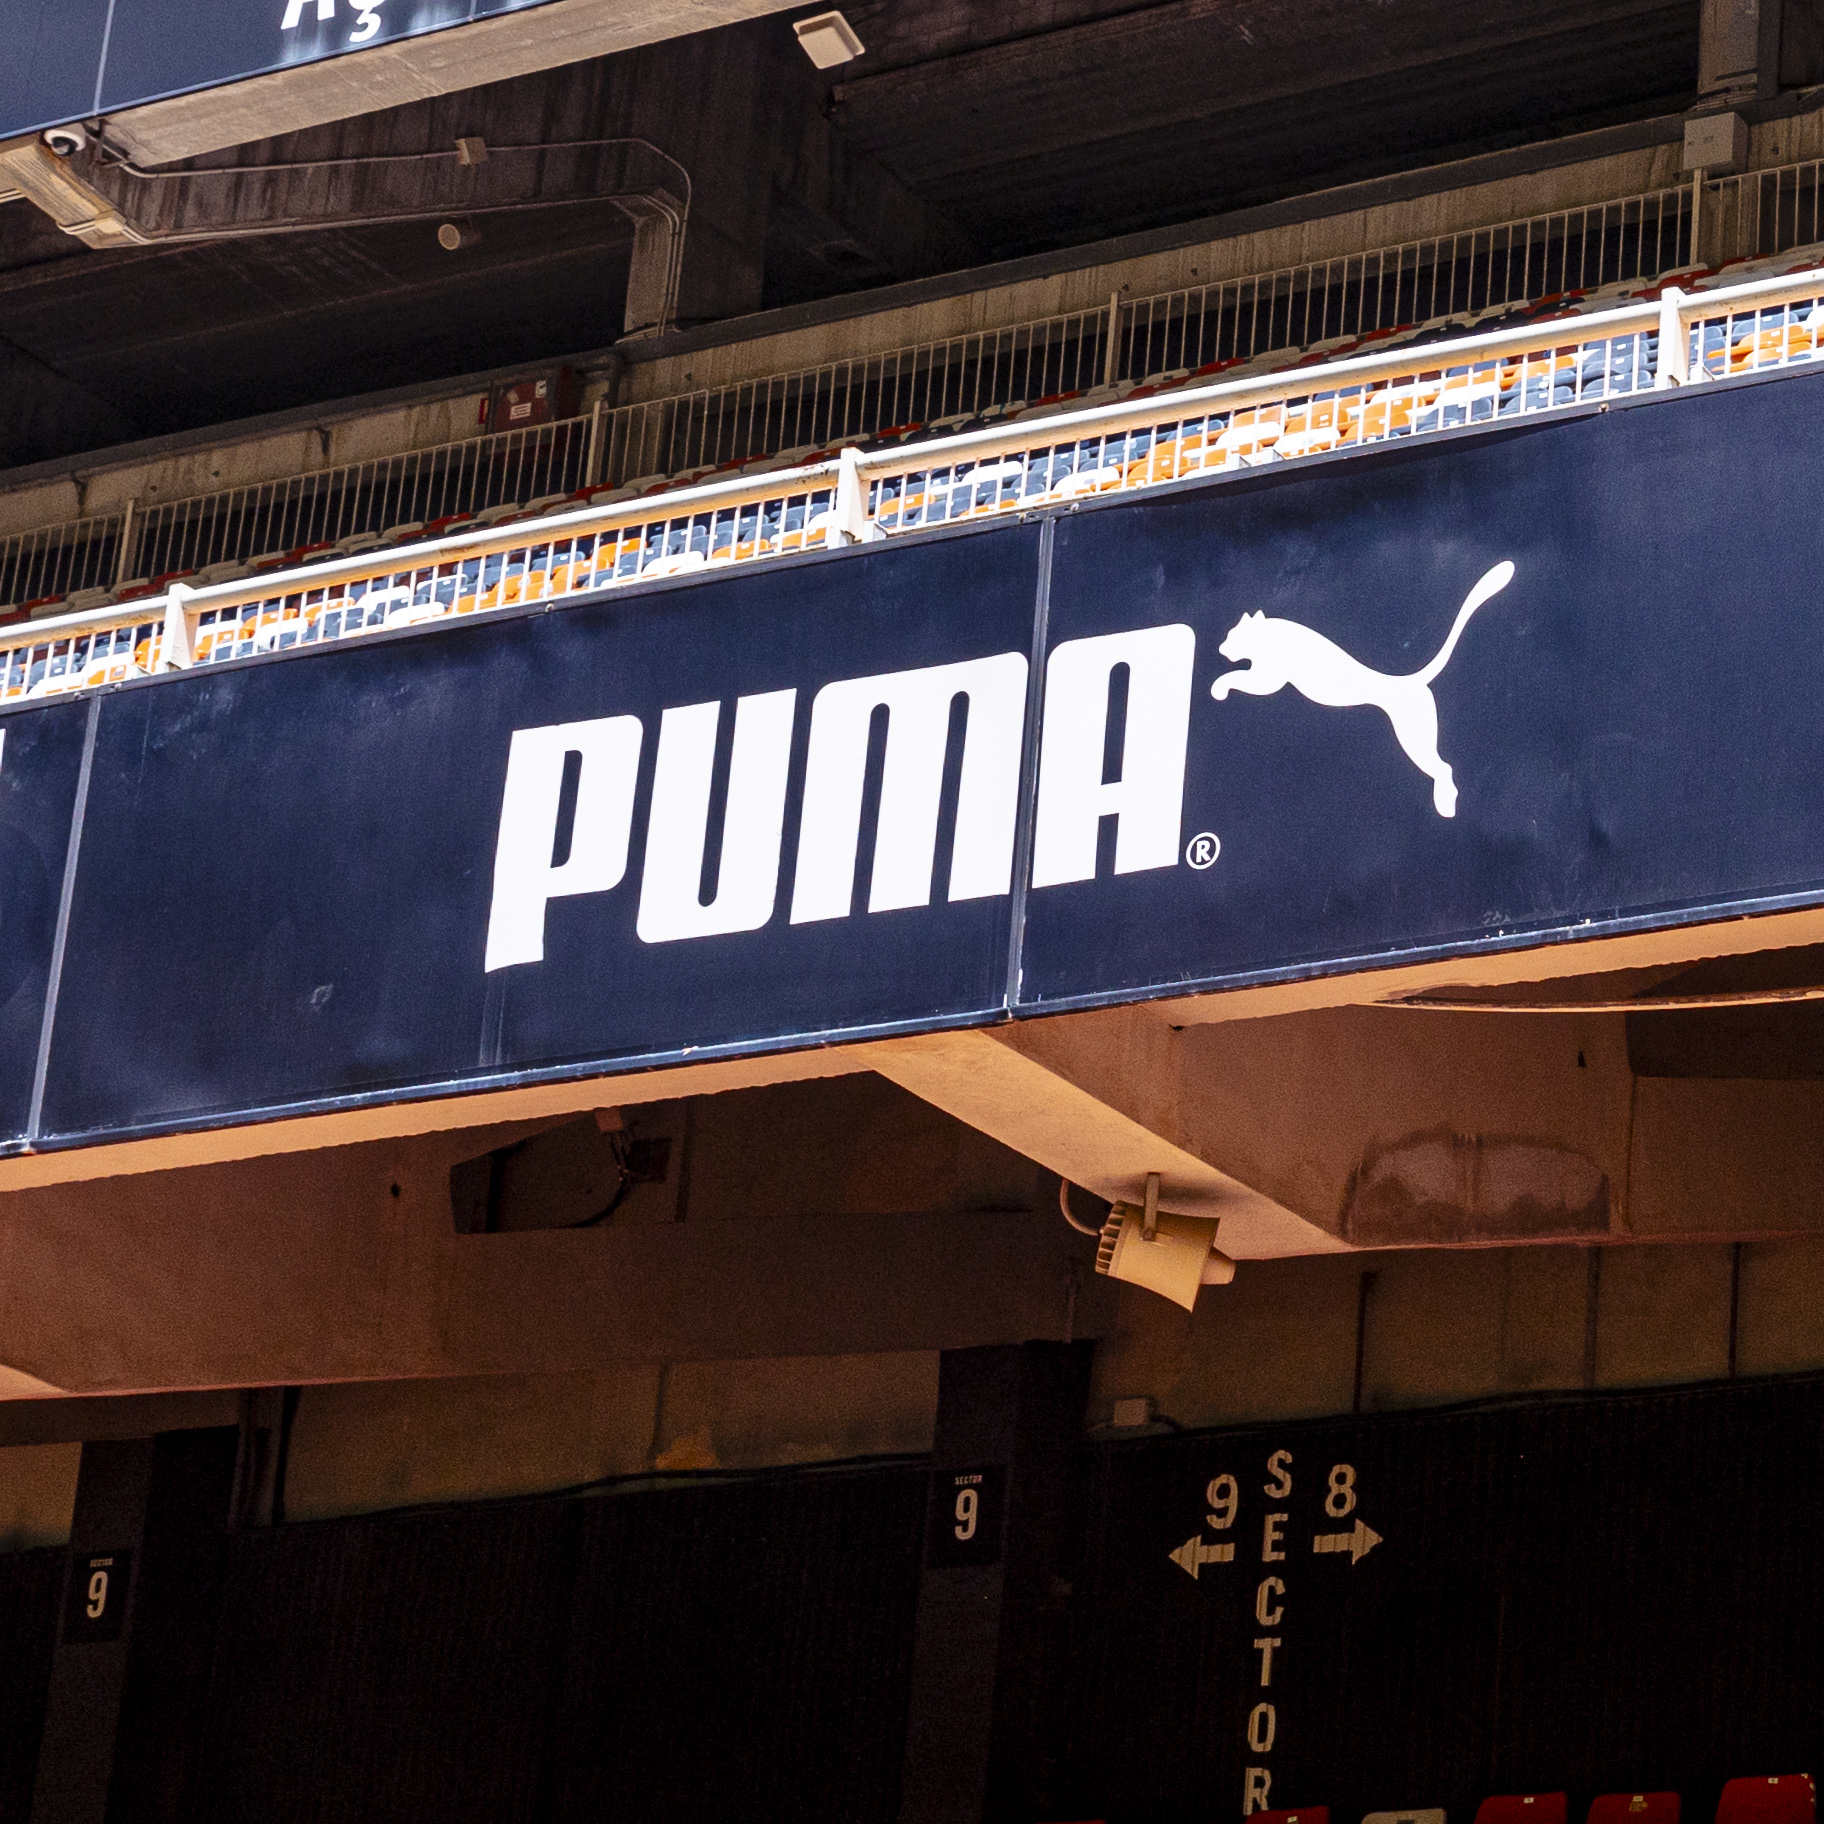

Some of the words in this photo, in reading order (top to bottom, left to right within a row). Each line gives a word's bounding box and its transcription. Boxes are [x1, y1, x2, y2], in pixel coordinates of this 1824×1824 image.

[485, 624, 1195, 972] PUMA
[954, 1488, 978, 1540] 9
[1206, 1474, 1238, 1529] 9
[1325, 1464, 1356, 1517] 8
[87, 1571, 108, 1618] 9
[1243, 1450, 1293, 1816] SECTOR
